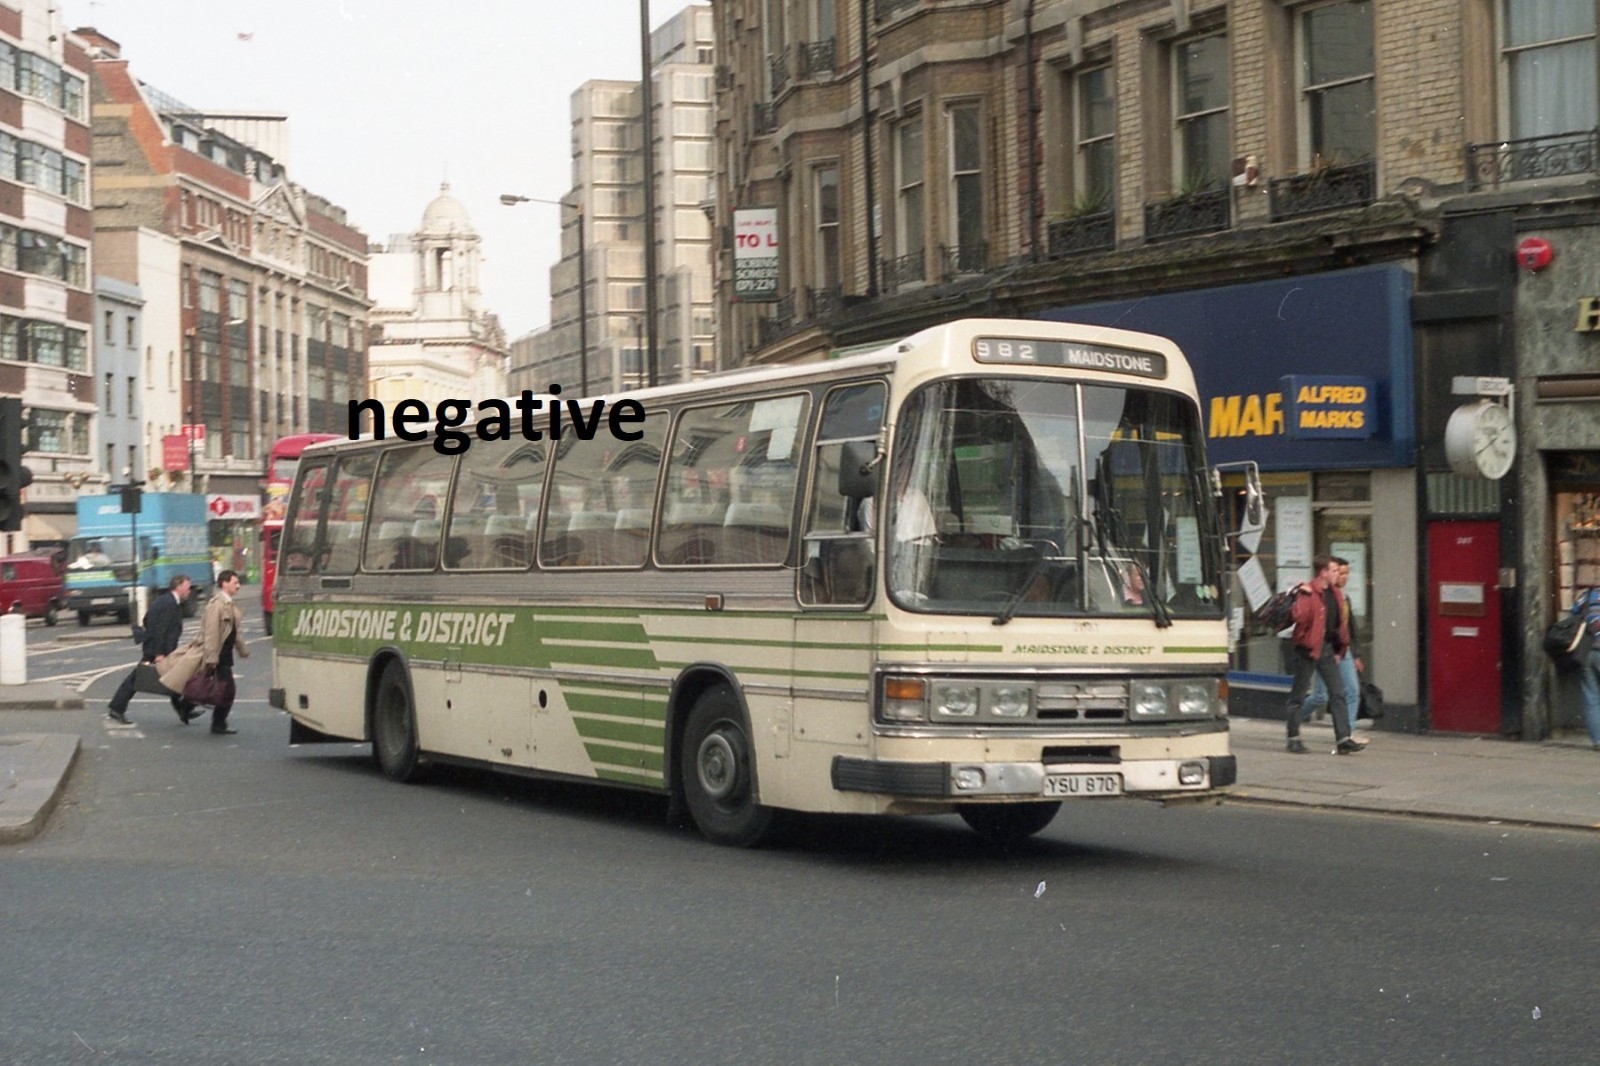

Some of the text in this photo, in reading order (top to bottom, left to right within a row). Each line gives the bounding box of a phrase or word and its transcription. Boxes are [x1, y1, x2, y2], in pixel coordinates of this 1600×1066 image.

[736, 234, 760, 247] TO
[1068, 348, 1153, 372] MAIDSTONE
[1296, 385, 1368, 404] ALFRED
[1299, 410, 1365, 429] MARKS
[292, 608, 515, 646] MAIDSTONE & DISTRICT
[1012, 645, 1089, 655] MAIDSTONE
[1103, 646, 1155, 656] DISTRICT
[1048, 776, 1115, 793] YSU 870
